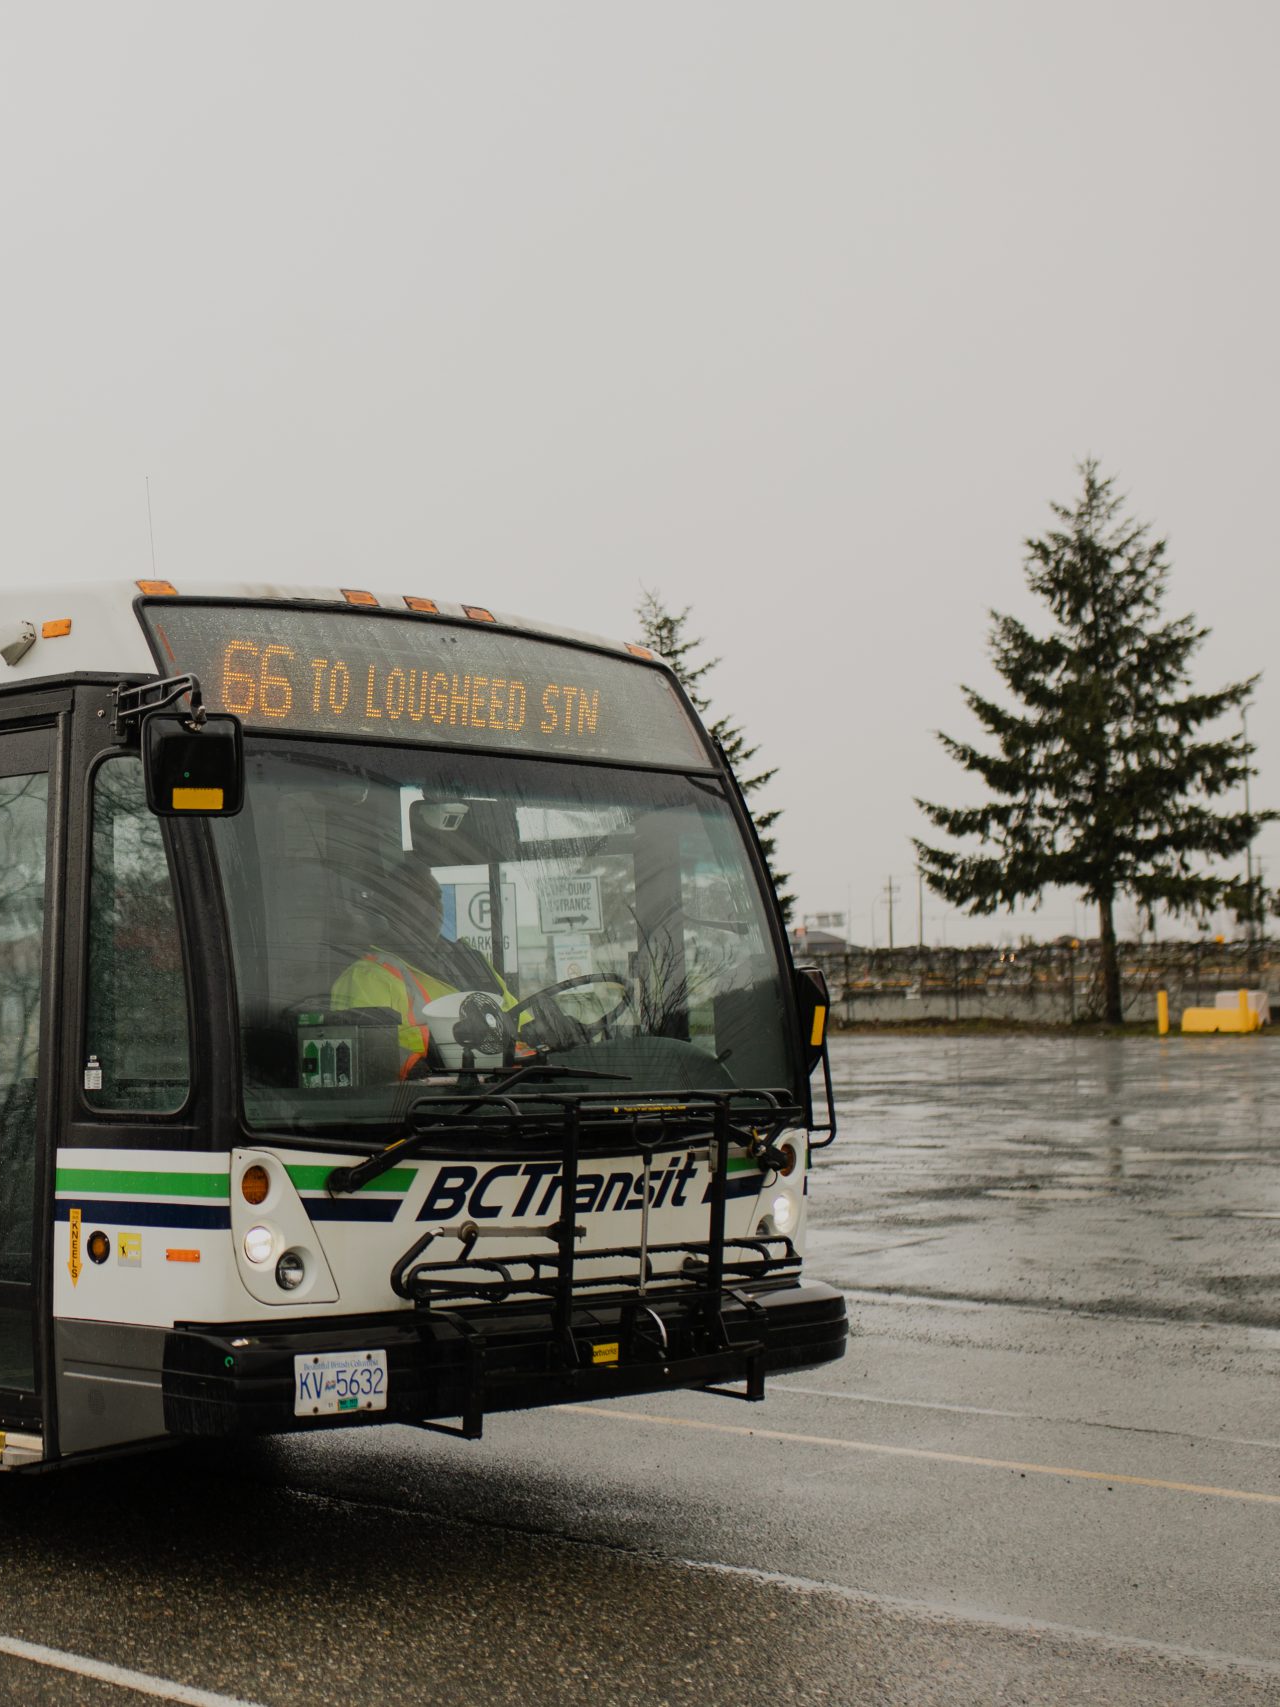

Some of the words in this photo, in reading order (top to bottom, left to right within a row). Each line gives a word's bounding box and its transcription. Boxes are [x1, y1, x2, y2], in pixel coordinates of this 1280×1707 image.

[222, 640, 295, 718] 66
[311, 659, 350, 714] TO
[366, 664, 527, 731] LOUGHEED
[540, 683, 601, 736] STN
[548, 896, 592, 913] TRANCE
[466, 935, 510, 951] ARKG
[70, 1221, 80, 1279] KNEELS
[299, 1371, 324, 1400] KV
[336, 1367, 384, 1397] 5632
